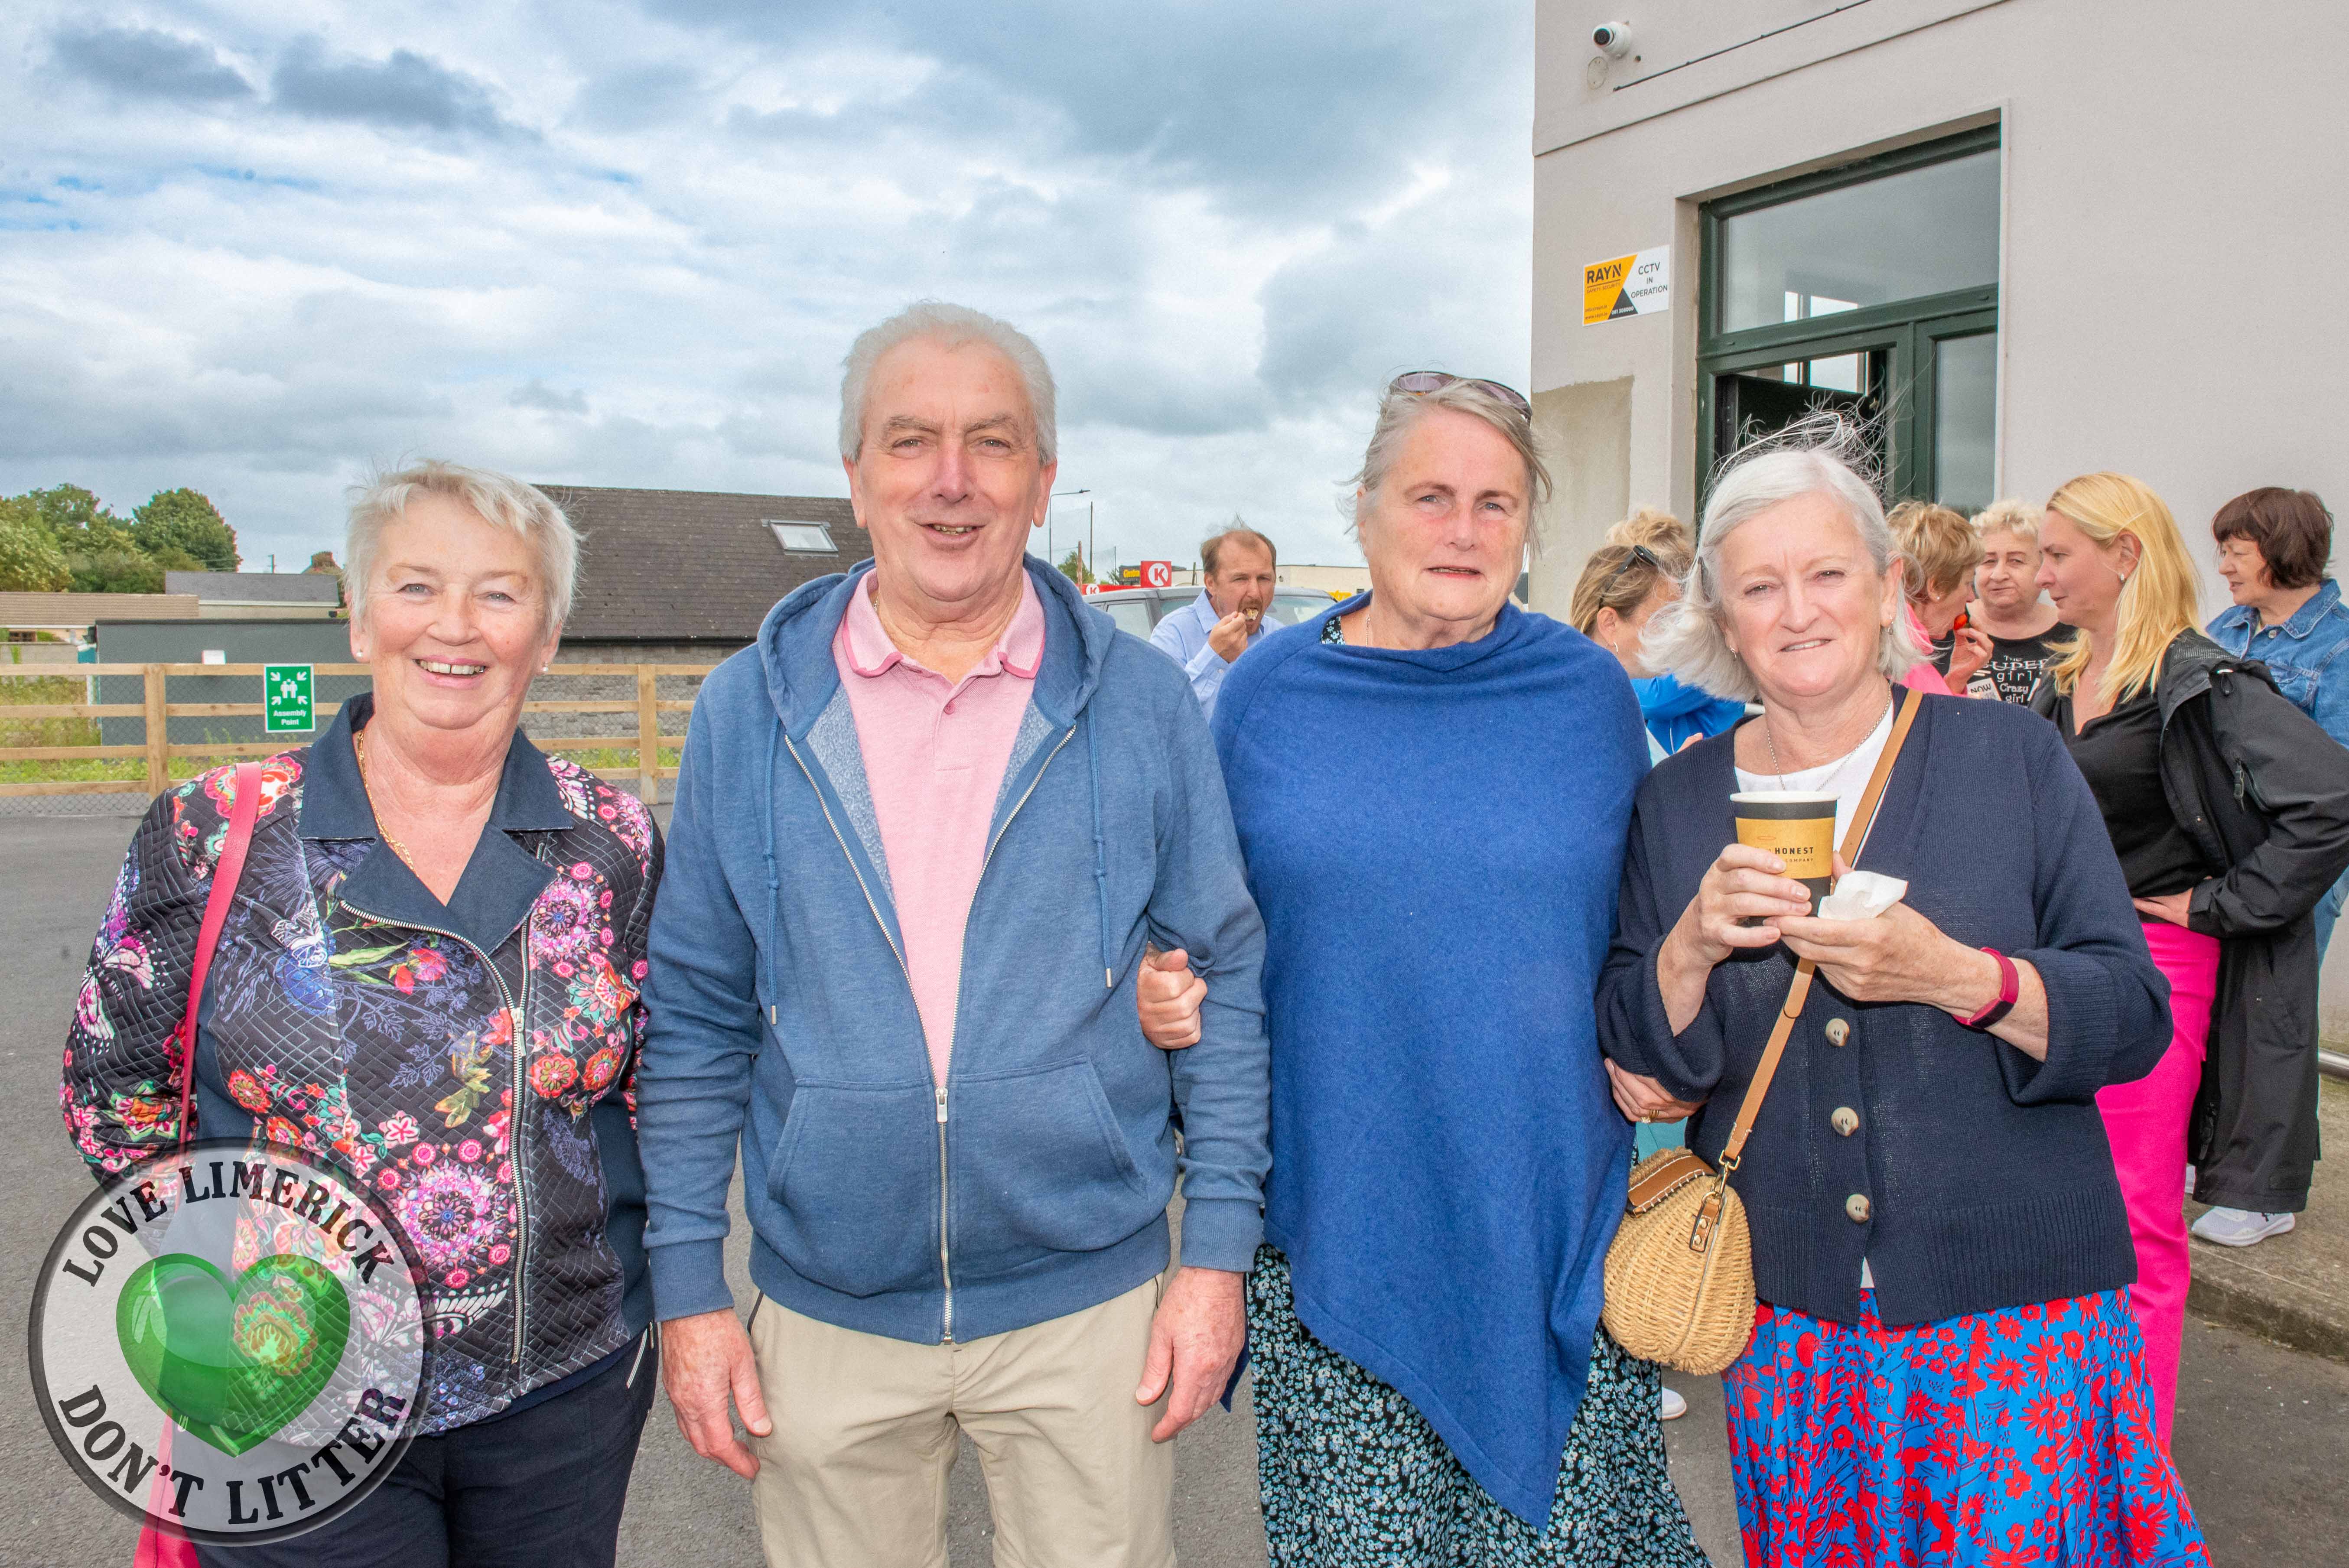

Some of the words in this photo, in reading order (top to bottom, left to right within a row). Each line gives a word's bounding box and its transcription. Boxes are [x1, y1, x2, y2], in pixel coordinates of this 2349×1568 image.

[1587, 264, 1621, 284] RAYN
[1638, 262, 1660, 275] CCTV
[1631, 285, 1668, 299] OPERATION
[1154, 568, 1167, 583] K
[1997, 670, 2032, 682] girl
[2000, 683, 2029, 694] Crazy
[2005, 693, 2024, 703] girl
[1775, 846, 1814, 855] HONEST
